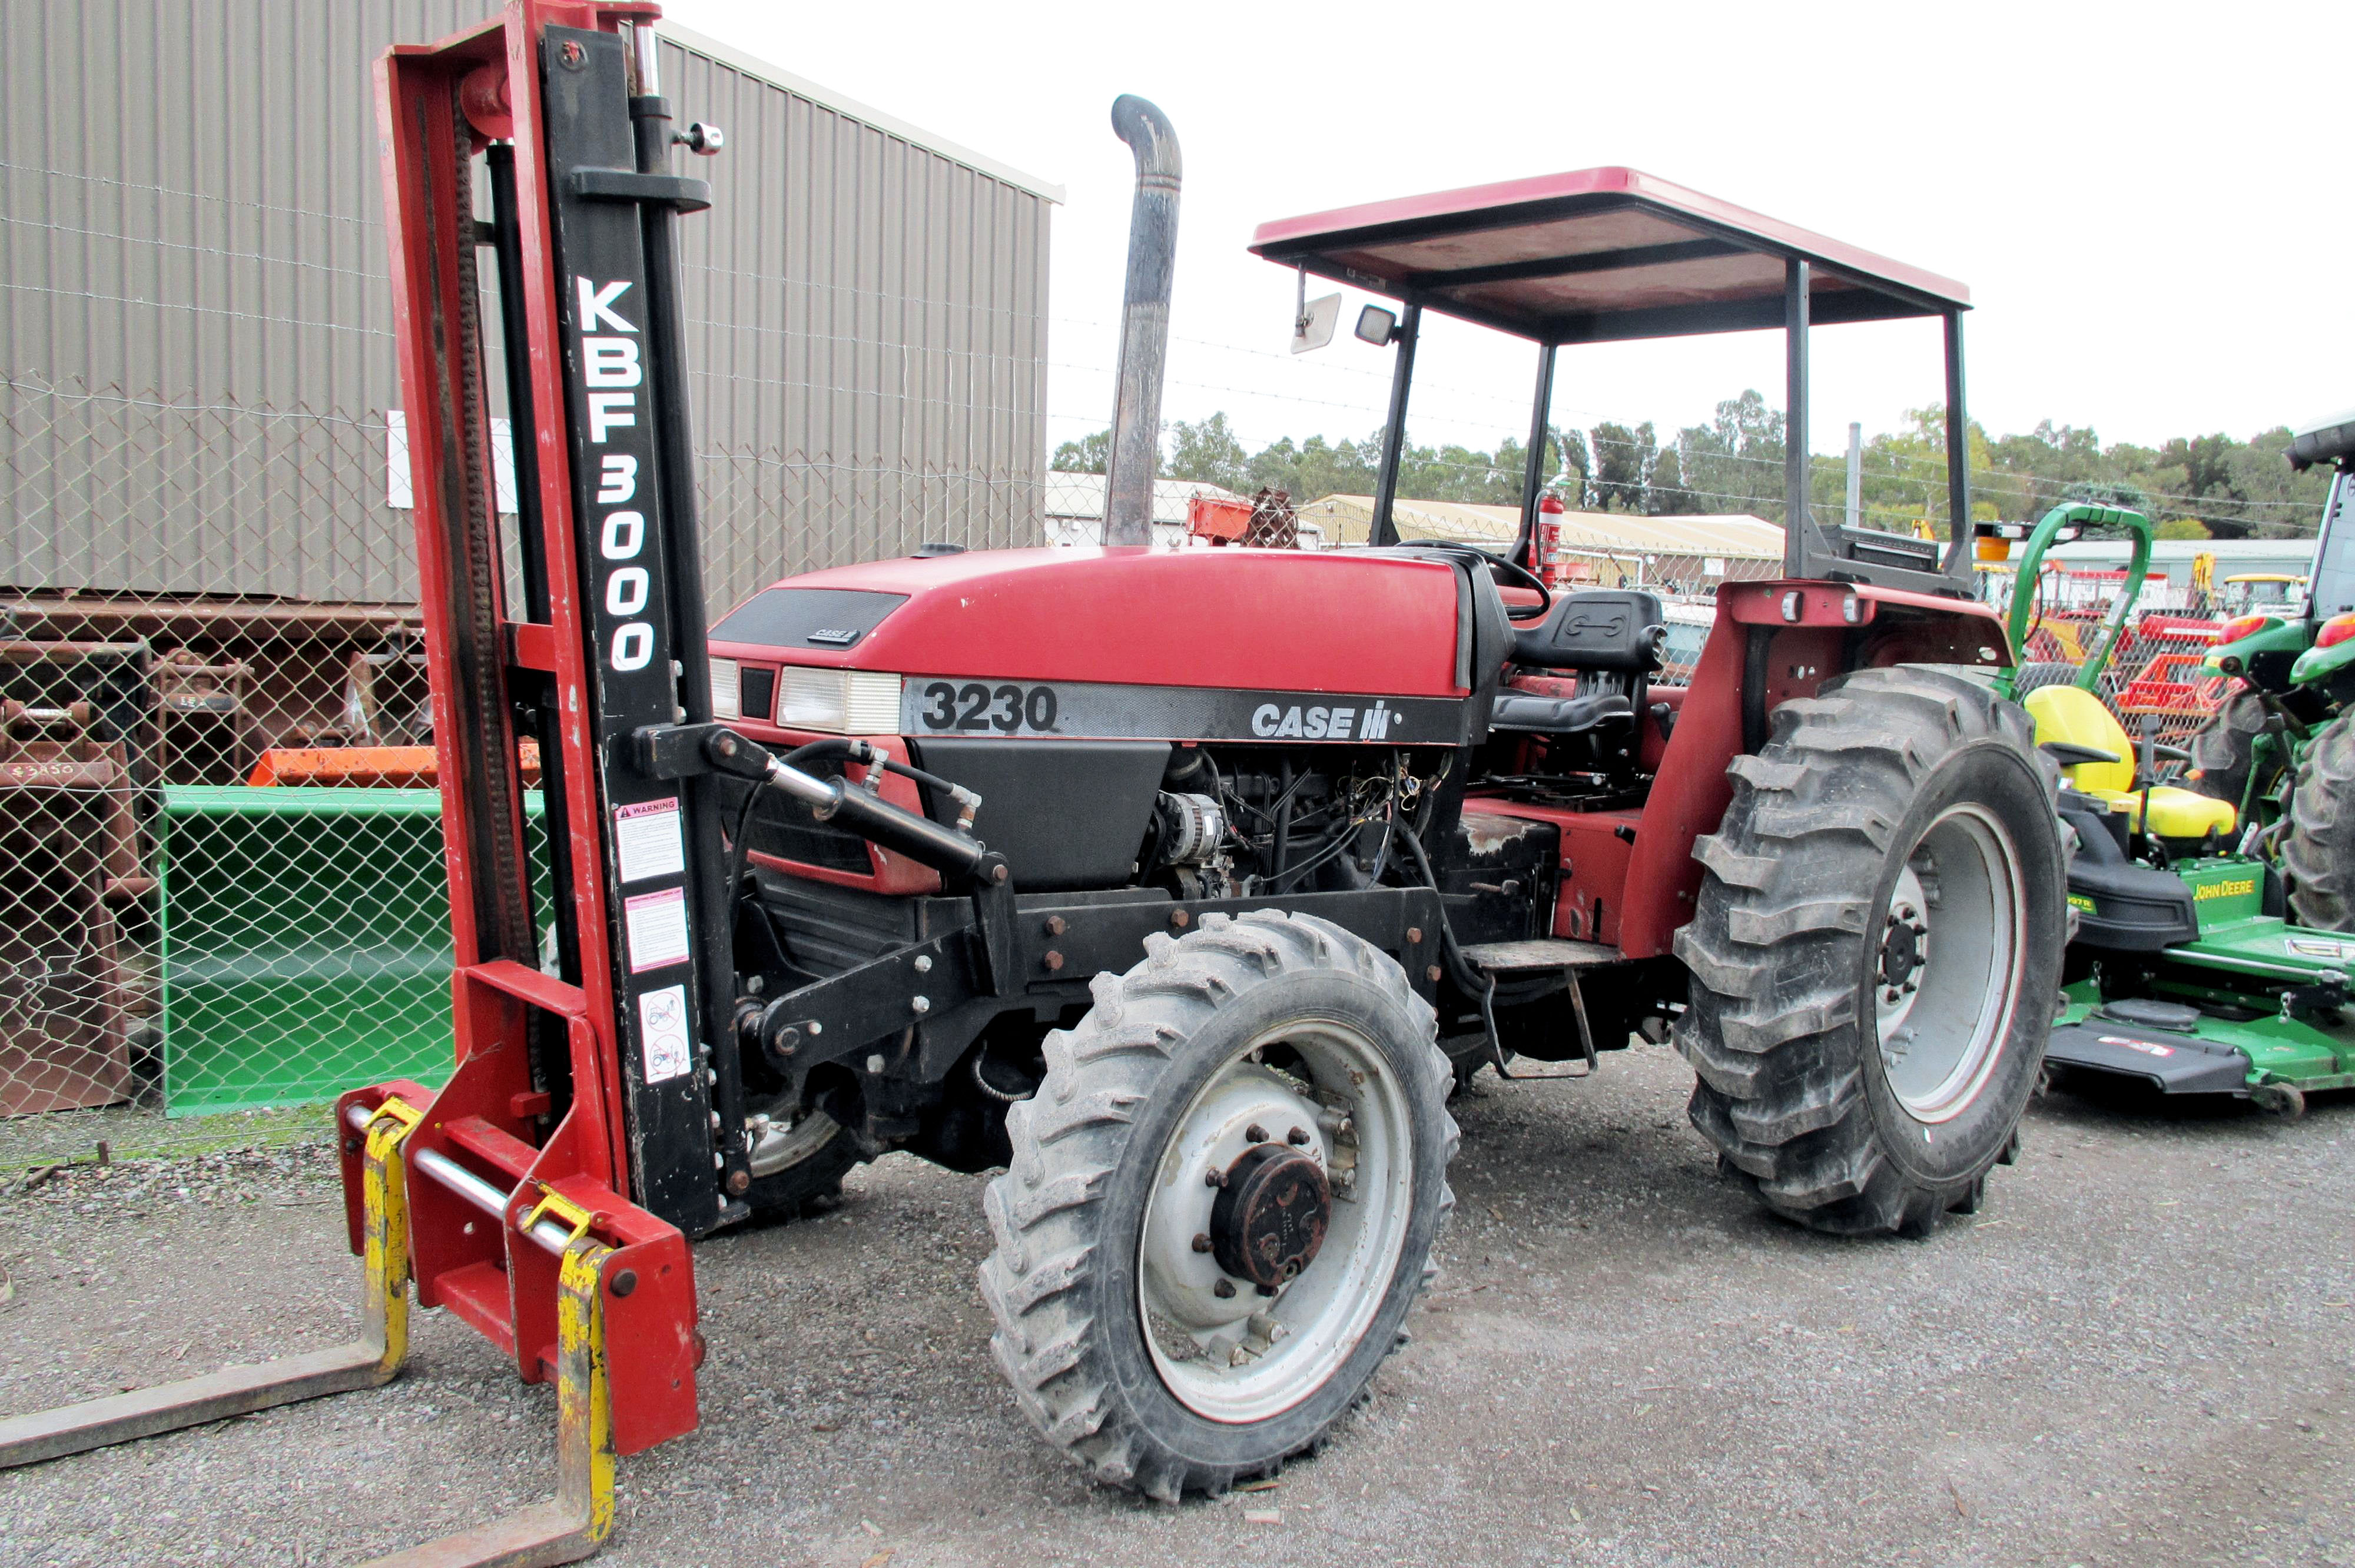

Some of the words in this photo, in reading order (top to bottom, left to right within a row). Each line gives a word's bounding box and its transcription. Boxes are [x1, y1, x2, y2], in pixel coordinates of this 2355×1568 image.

[815, 629, 848, 637] CASE
[922, 681, 1058, 732] 3230
[1251, 703, 1356, 739] CASE
[633, 800, 675, 815] WARNING
[2193, 883, 2220, 901] JOHN
[2221, 880, 2254, 896] DEERE
